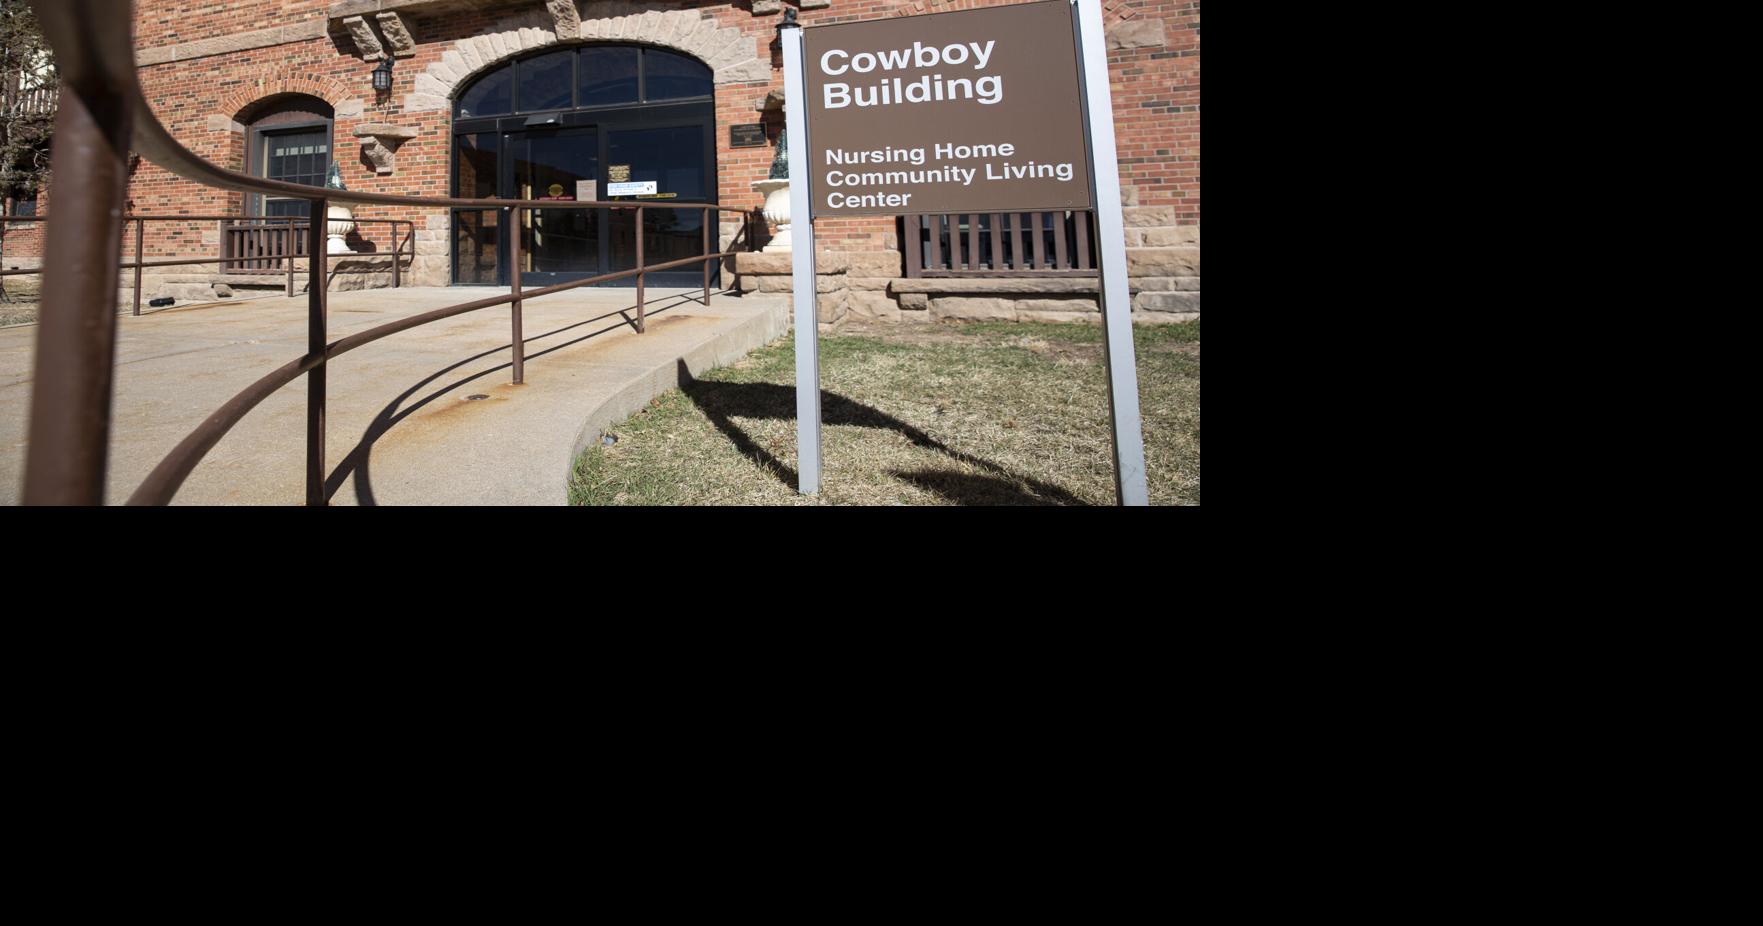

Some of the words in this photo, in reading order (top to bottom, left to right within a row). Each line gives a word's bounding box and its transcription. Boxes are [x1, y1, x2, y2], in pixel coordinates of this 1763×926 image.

[820, 40, 996, 76] Cowboy
[822, 74, 1003, 110] Building
[825, 145, 926, 166] Nursing
[934, 142, 1015, 160] Home
[825, 165, 977, 187] Community
[985, 160, 1074, 182] Living
[826, 191, 912, 209] Center
